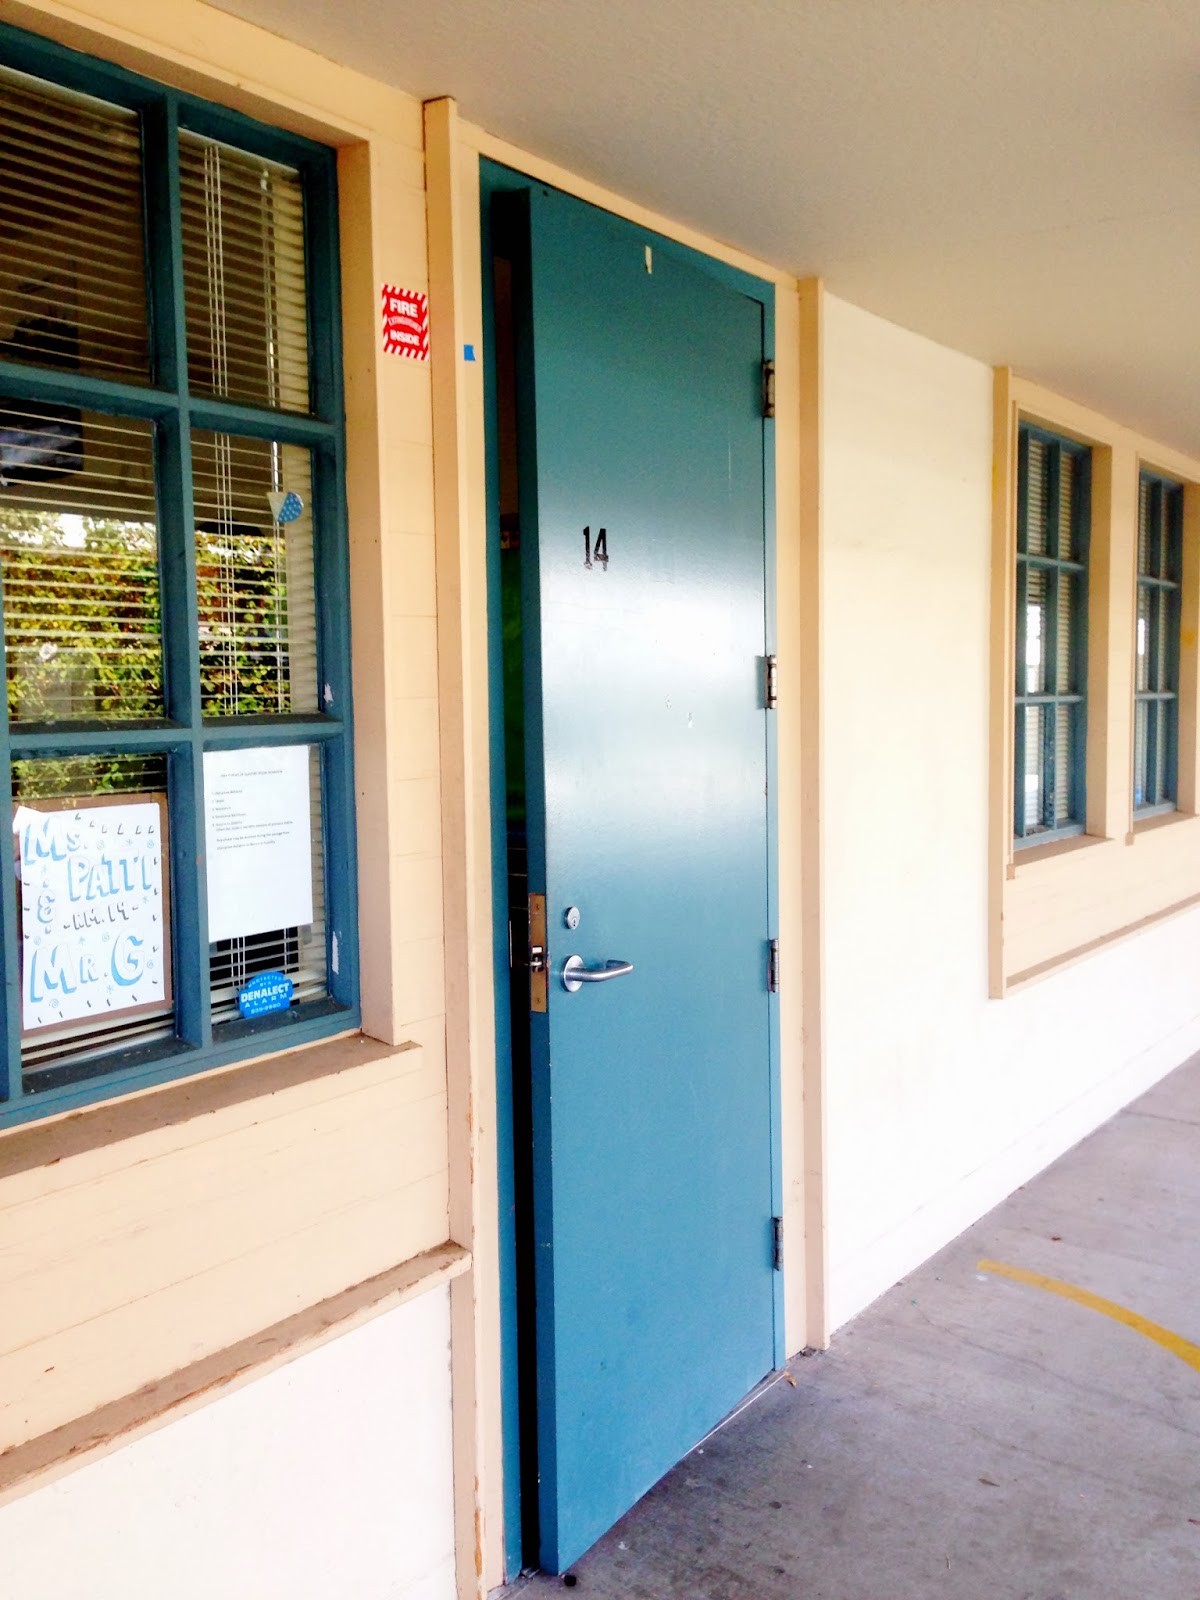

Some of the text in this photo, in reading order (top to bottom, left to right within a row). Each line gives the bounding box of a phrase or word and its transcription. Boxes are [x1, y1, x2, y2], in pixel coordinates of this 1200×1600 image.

[389, 297, 419, 318] FIRE
[389, 329, 420, 346] INSIDE
[583, 525, 609, 571] 14
[110, 931, 146, 987] G
[241, 982, 290, 1003] DENALECT
[244, 993, 288, 1009] ALARM
